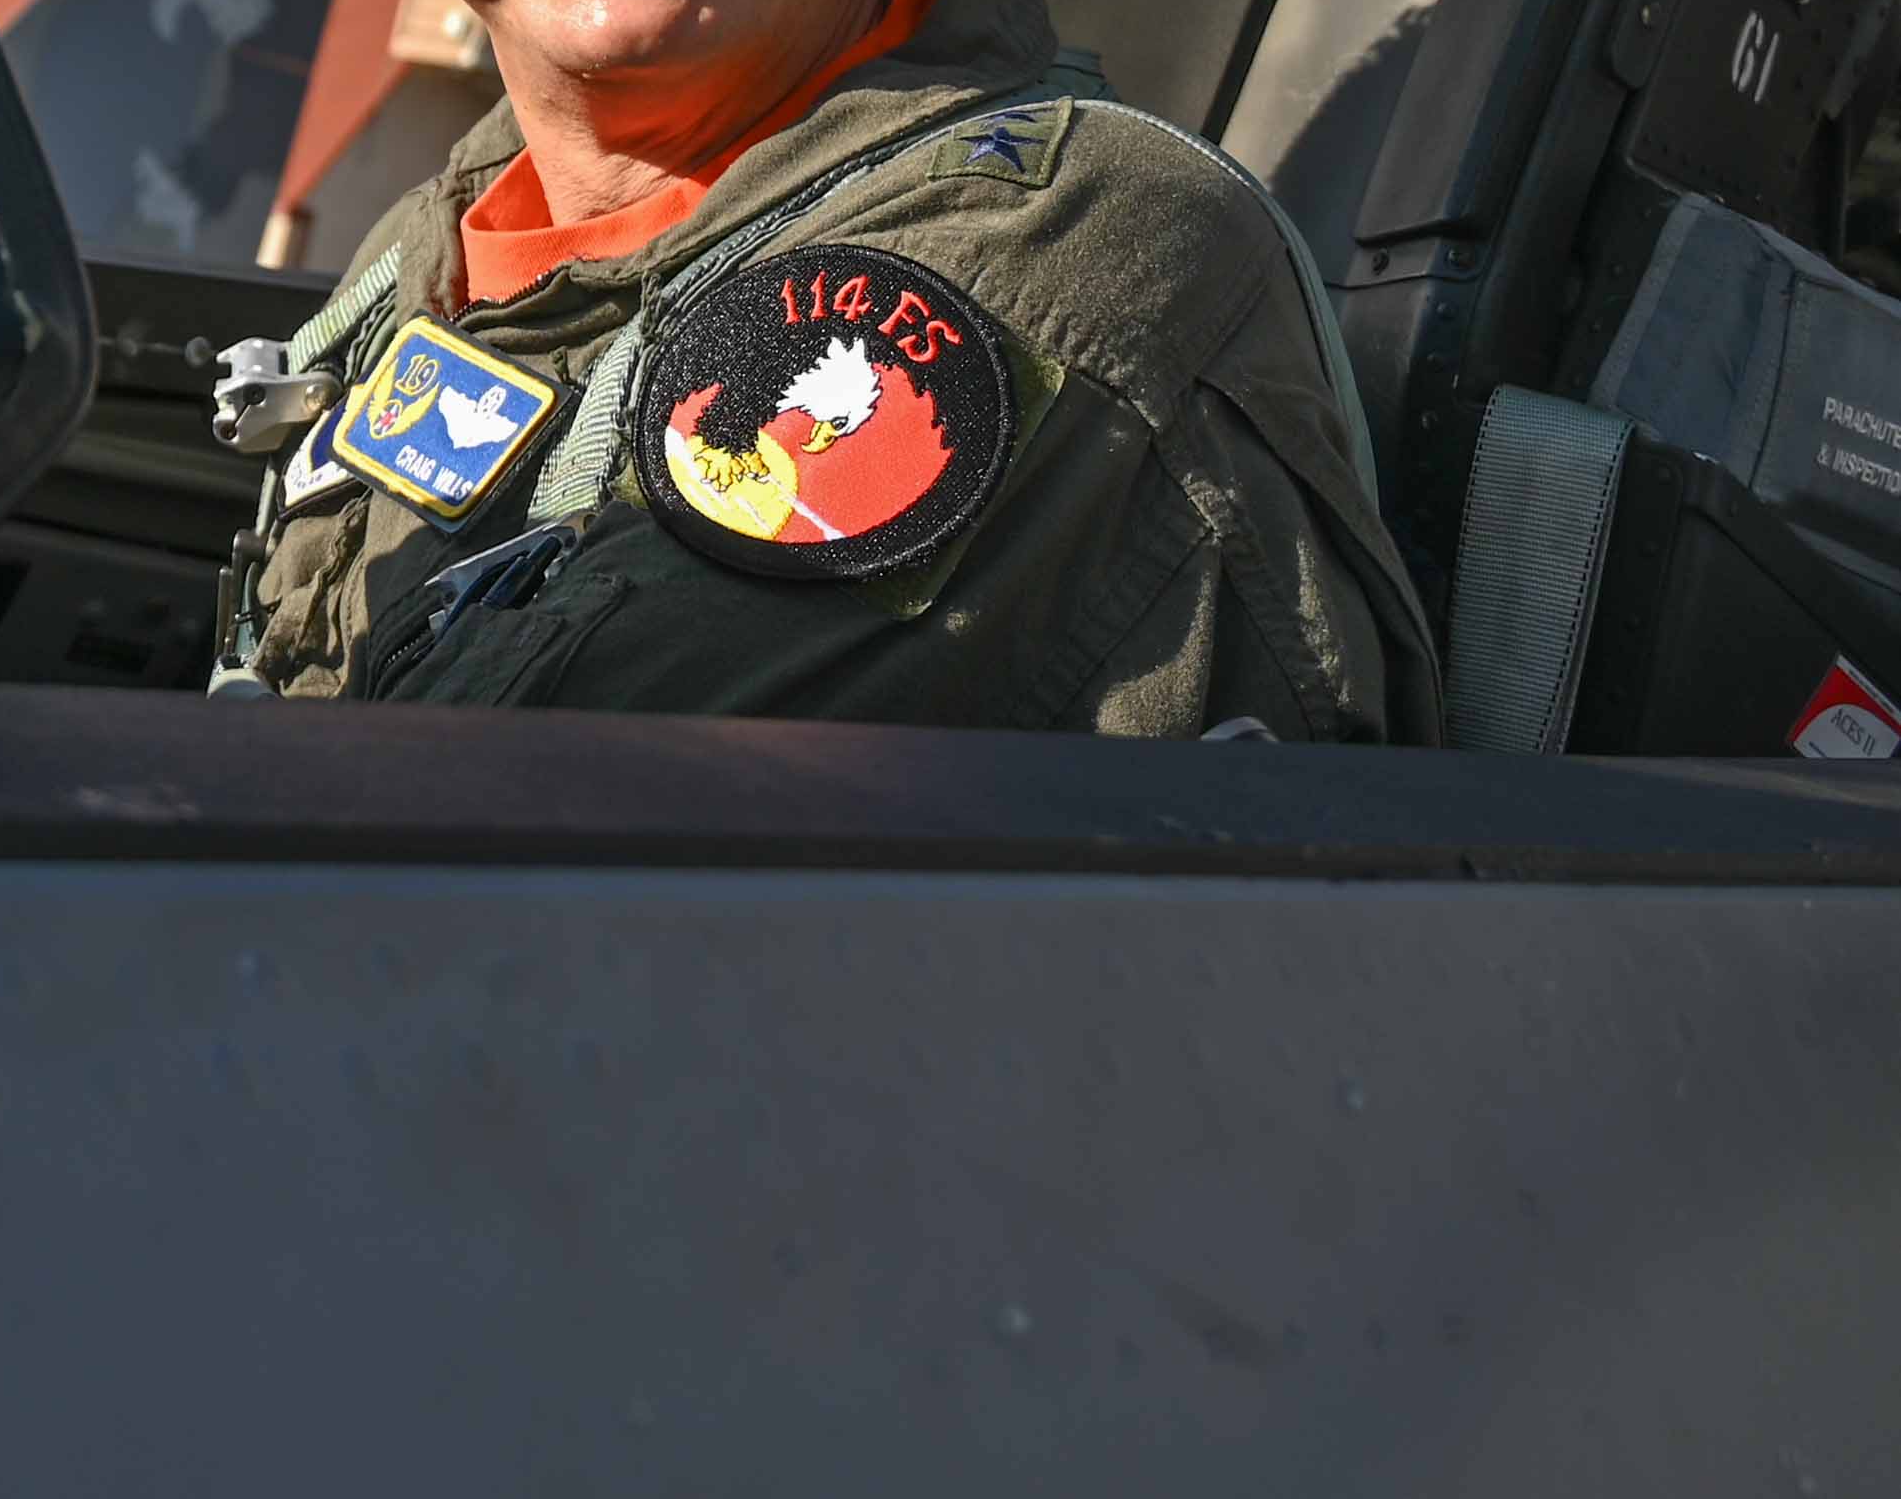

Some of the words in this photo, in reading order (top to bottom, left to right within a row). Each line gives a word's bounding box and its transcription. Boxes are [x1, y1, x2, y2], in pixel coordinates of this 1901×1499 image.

[780, 270, 873, 325] 114
[877, 290, 964, 364] FS
[394, 354, 439, 397] 19
[394, 444, 437, 482] CRAIG
[431, 465, 474, 501] WILLS
[1830, 708, 1865, 746] ACES
[1862, 734, 1876, 757] II
